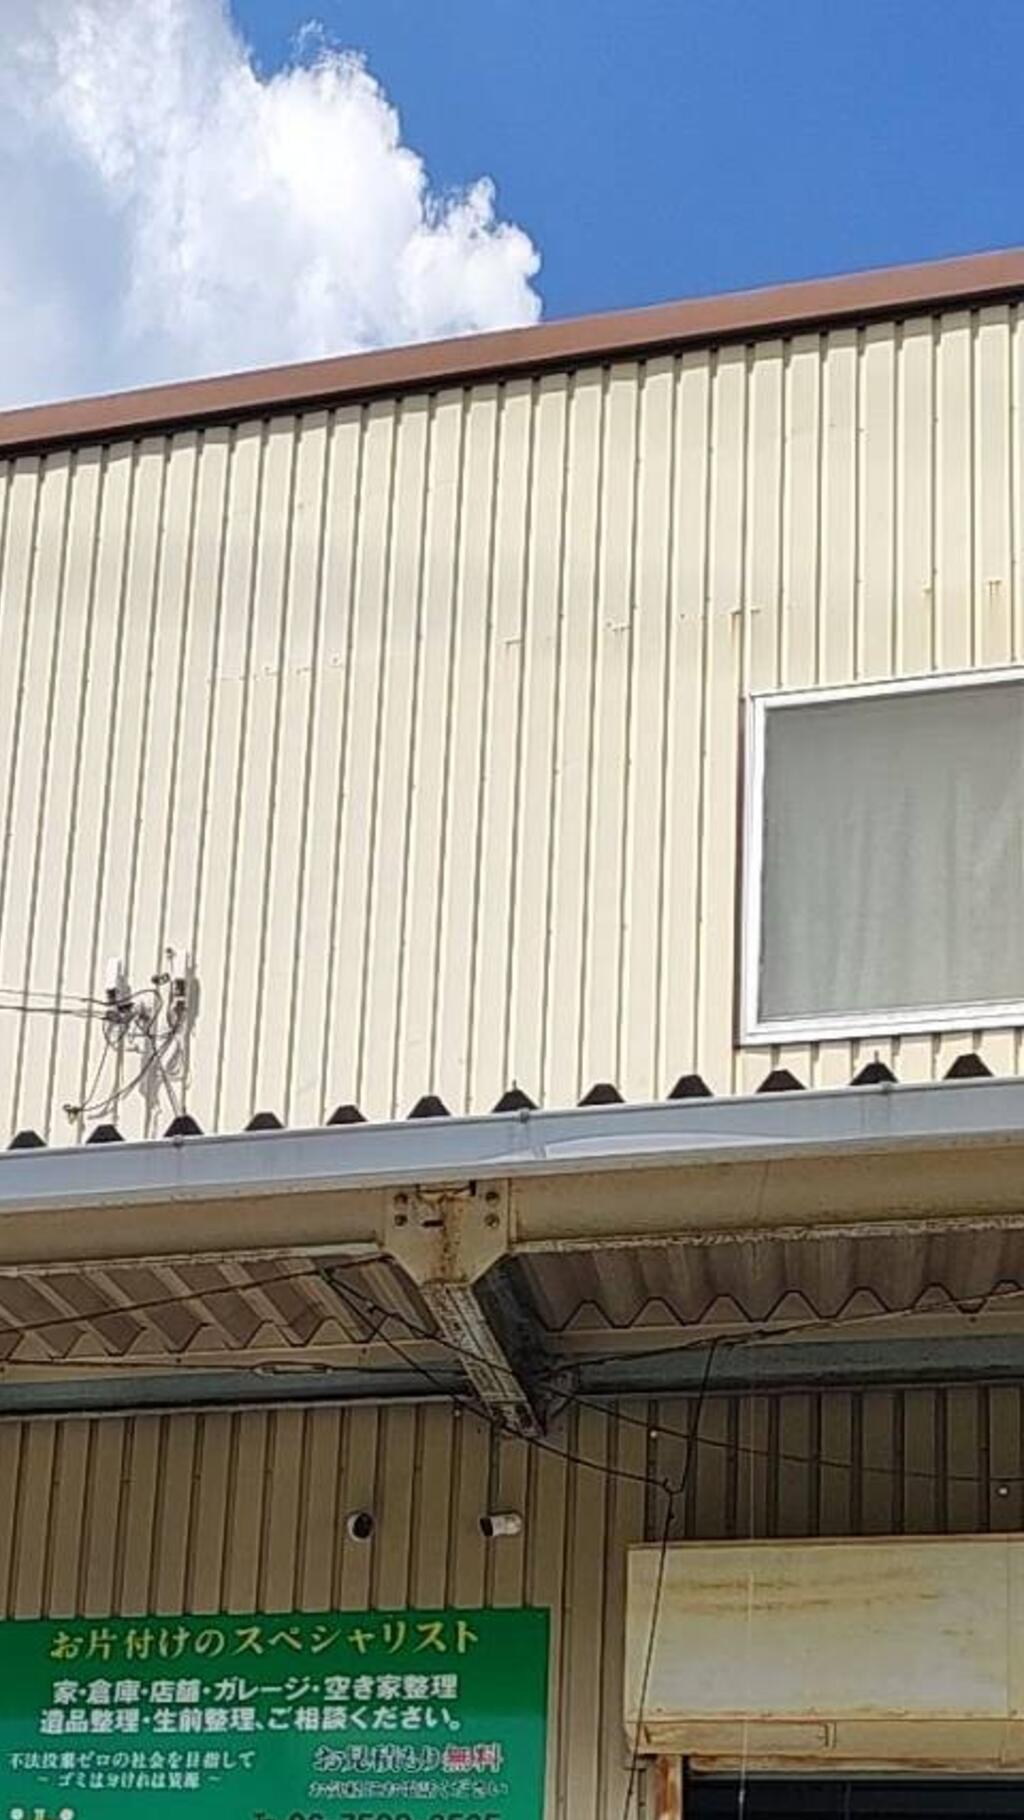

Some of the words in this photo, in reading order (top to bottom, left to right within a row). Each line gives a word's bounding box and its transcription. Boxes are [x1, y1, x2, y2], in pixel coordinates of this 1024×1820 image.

[49, 1618, 479, 1660] お片付けのスペシャリスト
[52, 1673, 458, 1706] 家・倉庫・店舗・ガレージ・空き家整理
[39, 1704, 462, 1735] 遺品整理・生前整理、ご相談ください。
